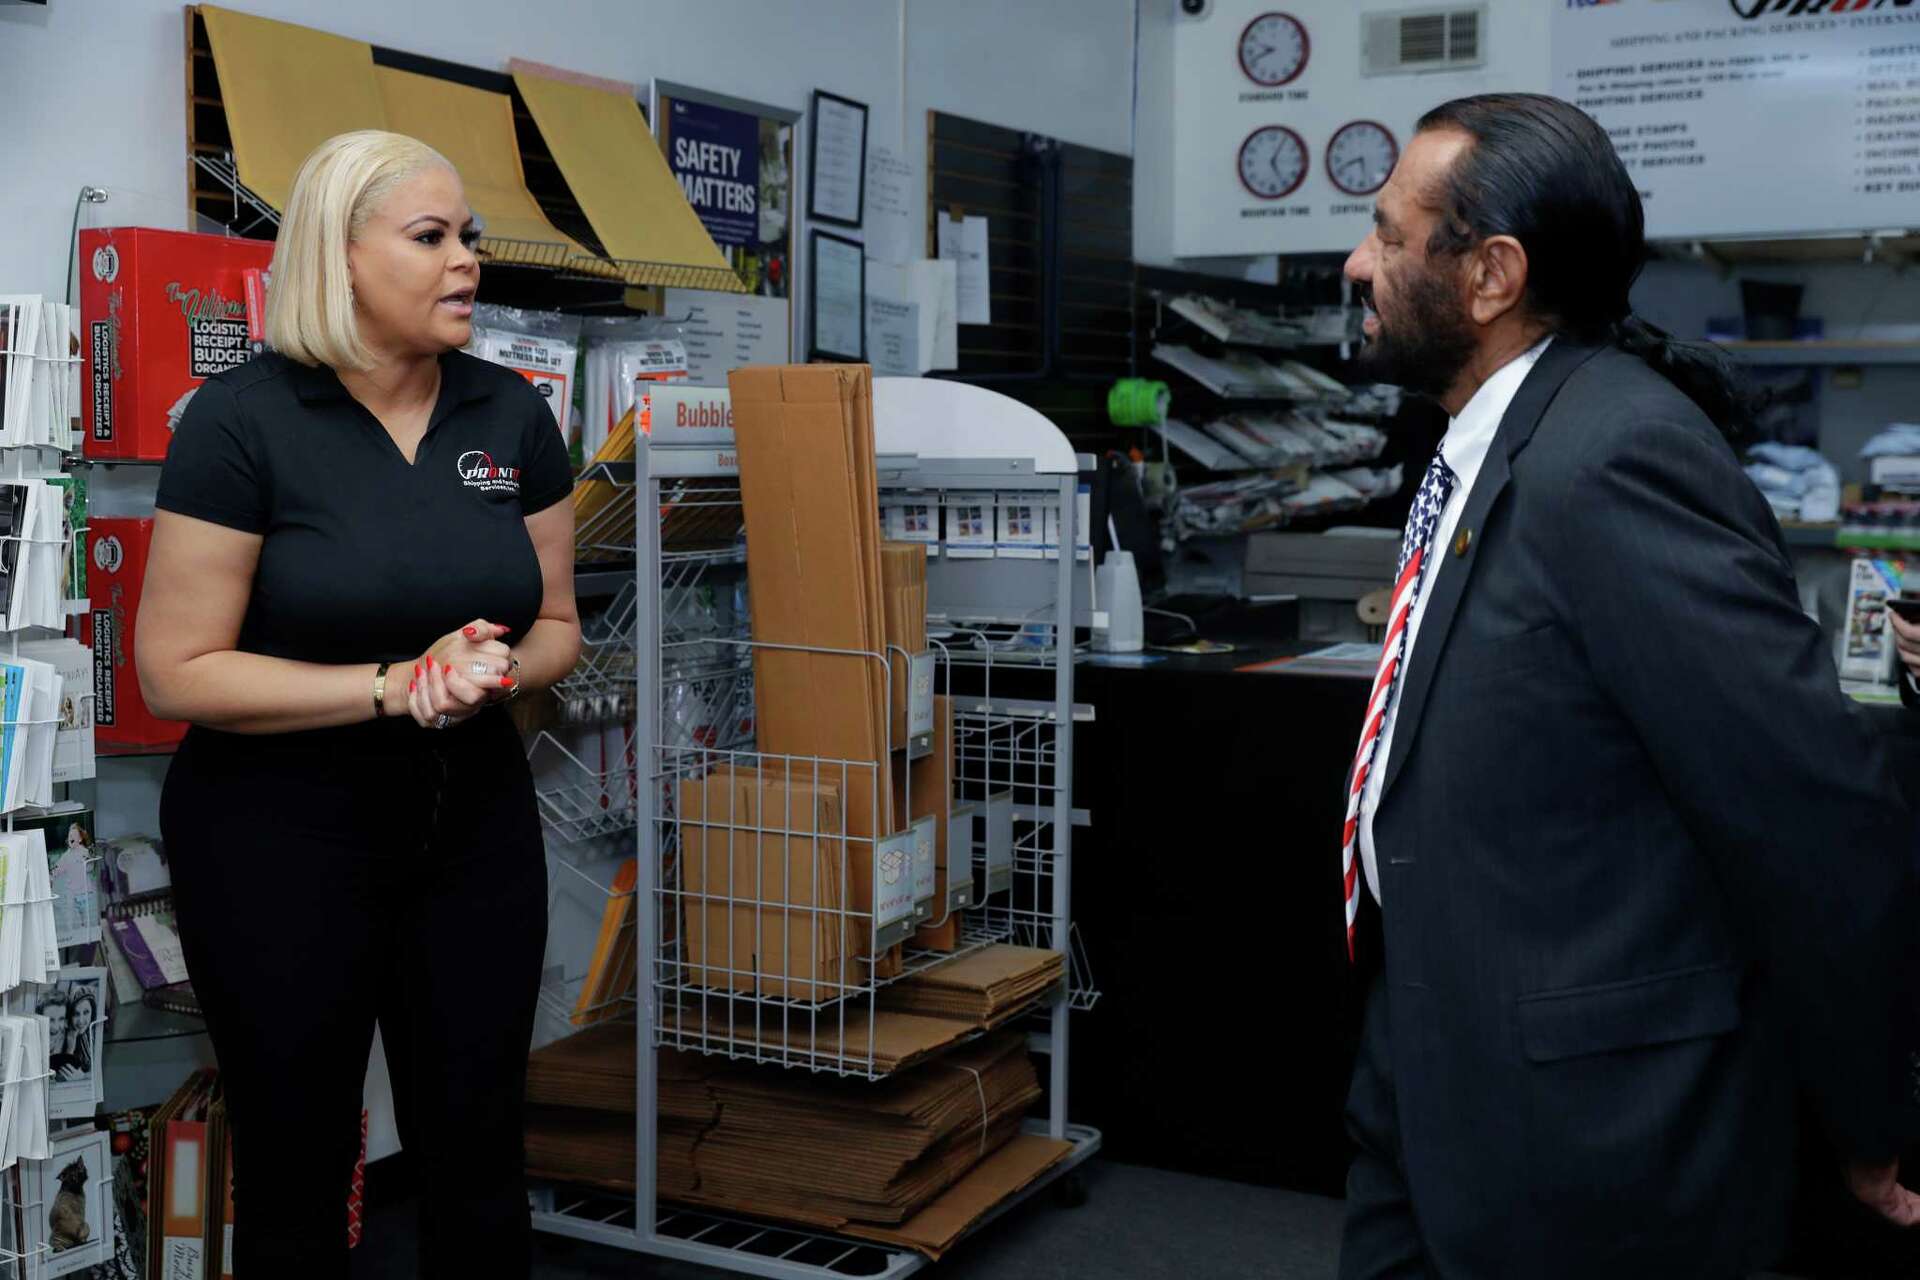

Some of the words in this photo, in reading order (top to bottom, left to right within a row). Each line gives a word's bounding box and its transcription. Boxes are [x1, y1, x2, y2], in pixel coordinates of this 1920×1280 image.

[675, 137, 741, 178] SAFETY
[676, 172, 756, 215] MATTERS
[102, 325, 110, 379] LOGISTICS
[194, 335, 242, 349] RECEIPT
[194, 348, 251, 364] BUDGET
[94, 372, 103, 437] ORGANIZER
[102, 381, 111, 426] RECEIPT
[677, 400, 736, 428] Bubble
[463, 480, 491, 488] Shipping
[95, 613, 103, 657] BUDGET
[103, 614, 111, 666] LOGISTICS
[96, 660, 104, 721] ORGANIZER
[104, 669, 112, 712] RECEIPT
